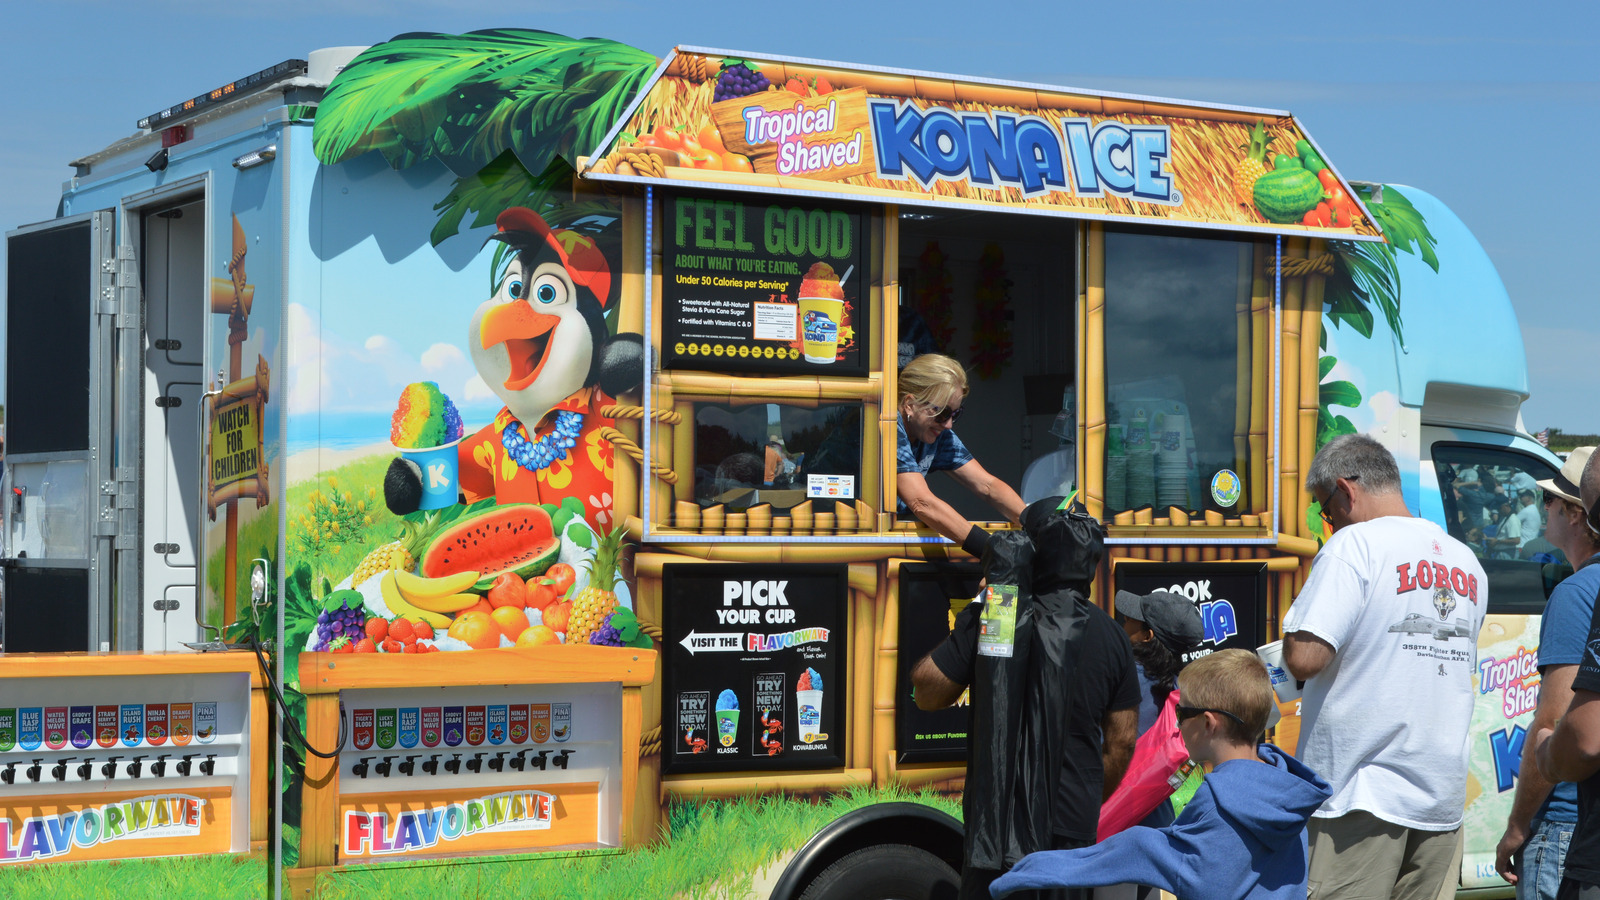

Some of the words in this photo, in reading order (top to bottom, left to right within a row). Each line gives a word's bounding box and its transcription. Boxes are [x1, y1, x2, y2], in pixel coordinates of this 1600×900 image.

[744, 100, 837, 145] Tropical
[778, 131, 861, 173] Shaved
[869, 102, 1066, 195] KONA
[1064, 117, 1172, 201] ICE
[675, 197, 754, 252] FEEL
[764, 204, 853, 259] GOOD
[675, 254, 704, 268] ABOUT
[708, 256, 733, 270] WHAT
[736, 258, 766, 272] YOU'RE
[768, 261, 802, 275] EATING.
[676, 275, 700, 284] Under
[701, 276, 712, 286] 50
[712, 277, 743, 288] Calories
[744, 281, 757, 290] per
[804, 332, 825, 342] KONA
[218, 404, 250, 434] WATCH
[226, 430, 244, 454] FOR
[215, 448, 258, 480] CHILDREN
[428, 463, 450, 489] K
[724, 580, 788, 606] PICK
[1152, 580, 1212, 603] OK
[1396, 559, 1478, 606] LOBOS
[716, 609, 760, 624] YOUR
[764, 609, 796, 624] CUP.
[691, 638, 716, 647] VISIT
[719, 638, 738, 647] THE
[748, 628, 830, 652] FLAVORWAVE
[1480, 648, 1538, 692] Tropica
[757, 680, 782, 691] TRY
[680, 699, 706, 710] TRY
[757, 696, 782, 705] NEW
[680, 714, 706, 723] NEW
[346, 791, 552, 854] FLAVORWAVE
